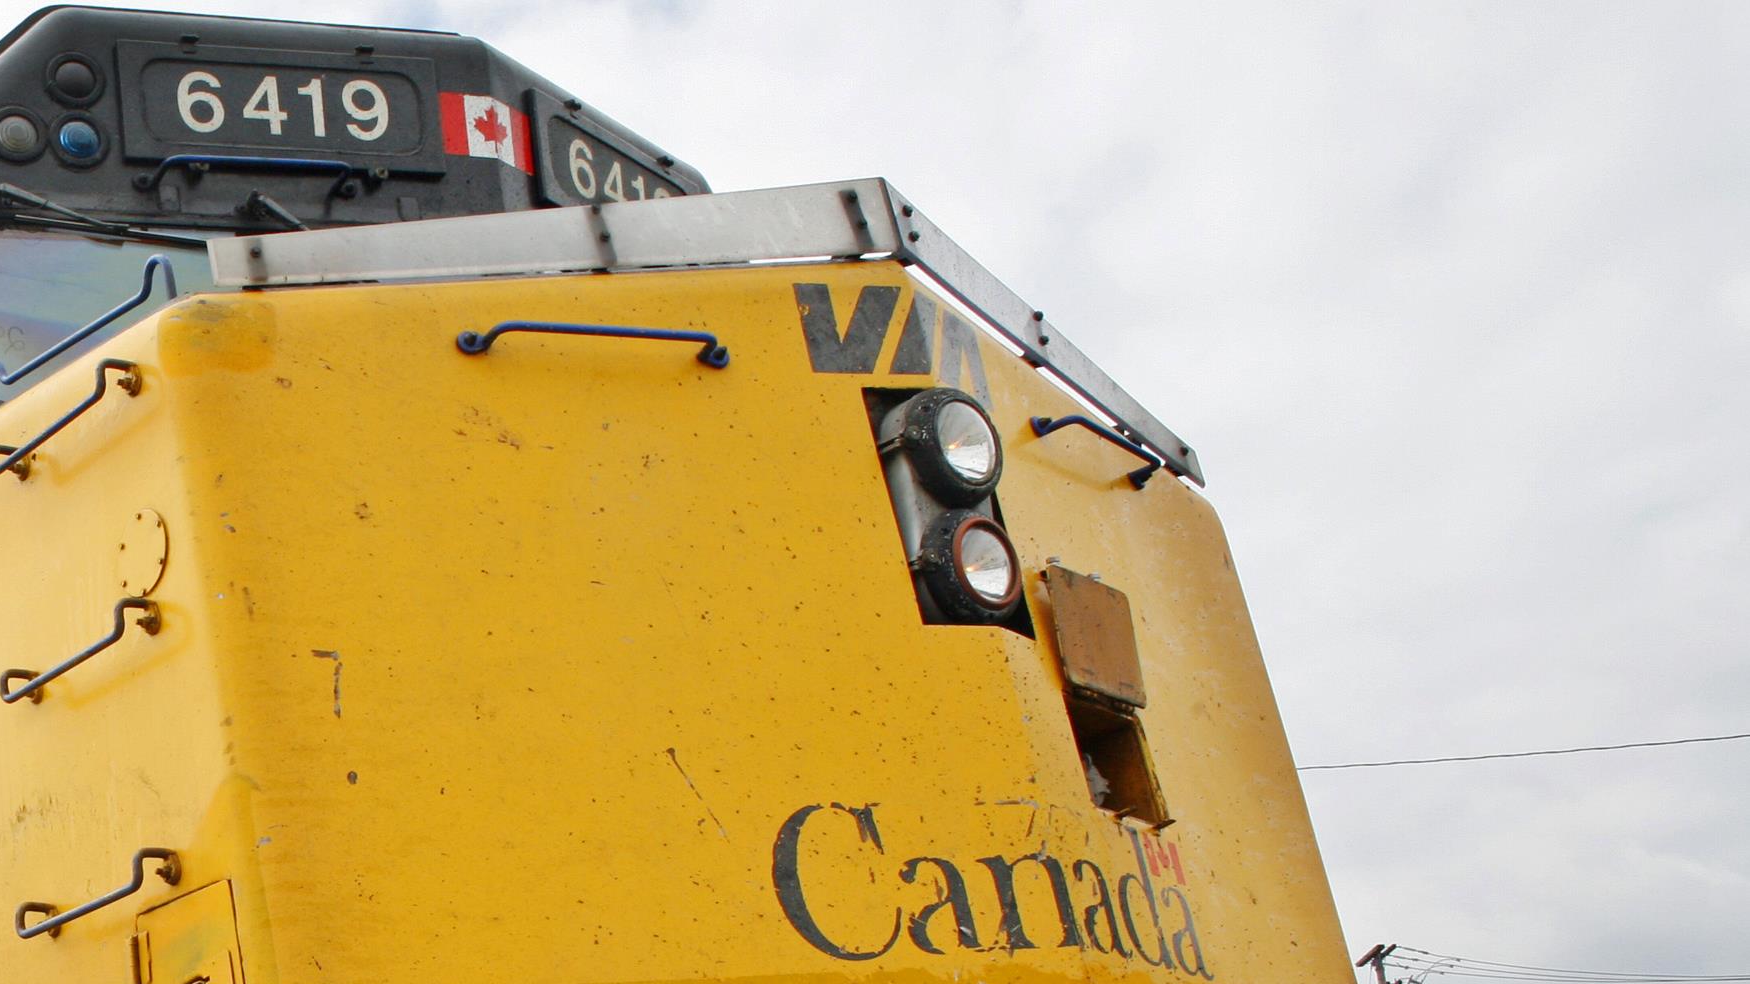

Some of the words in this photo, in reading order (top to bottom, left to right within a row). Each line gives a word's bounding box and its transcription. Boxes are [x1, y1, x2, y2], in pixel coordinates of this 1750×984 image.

[176, 71, 390, 142] 6419
[569, 139, 671, 202] 641
[792, 283, 994, 413] VIA
[771, 801, 1215, 982] Canada
